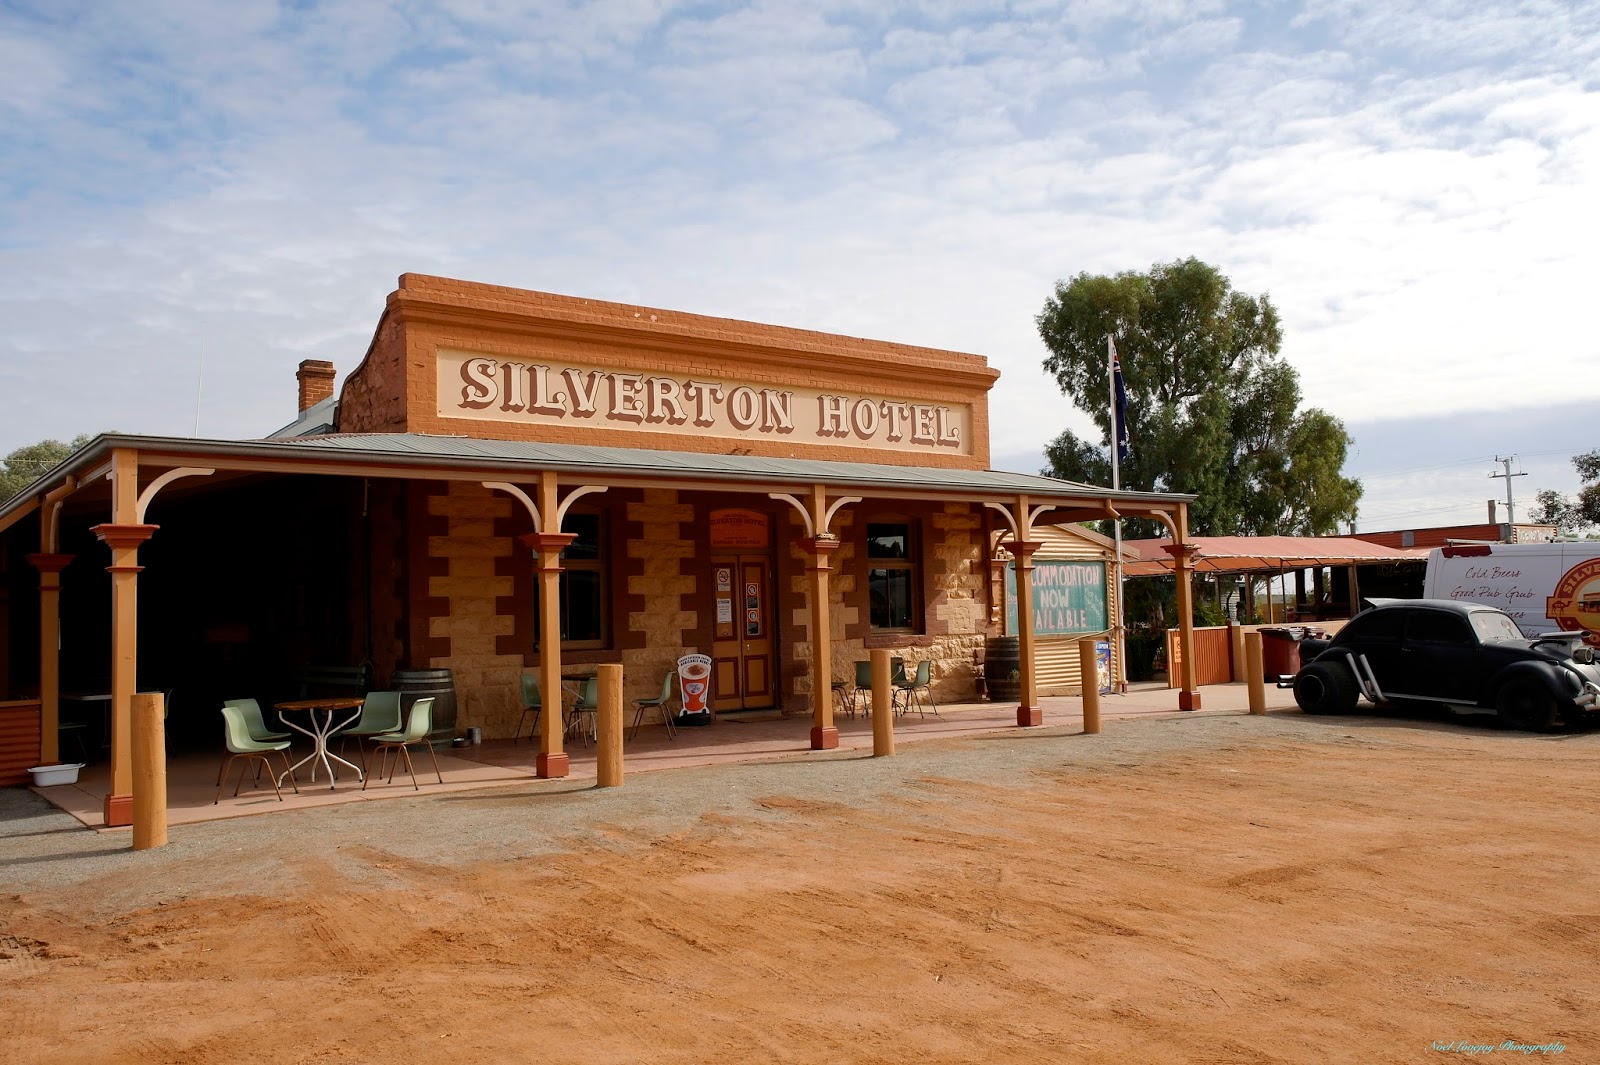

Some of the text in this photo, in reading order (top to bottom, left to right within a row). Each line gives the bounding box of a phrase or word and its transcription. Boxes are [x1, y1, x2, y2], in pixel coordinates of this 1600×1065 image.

[458, 357, 961, 447] SILVERTON HOTEL
[1031, 565, 1099, 586] COMMODATION
[1465, 566, 1522, 579] Cold Beers
[1563, 564, 1600, 594] SILVE
[1040, 589, 1069, 608] NOW
[1450, 585, 1536, 604] Good Pub Grub
[1033, 609, 1087, 630] AILABLE
